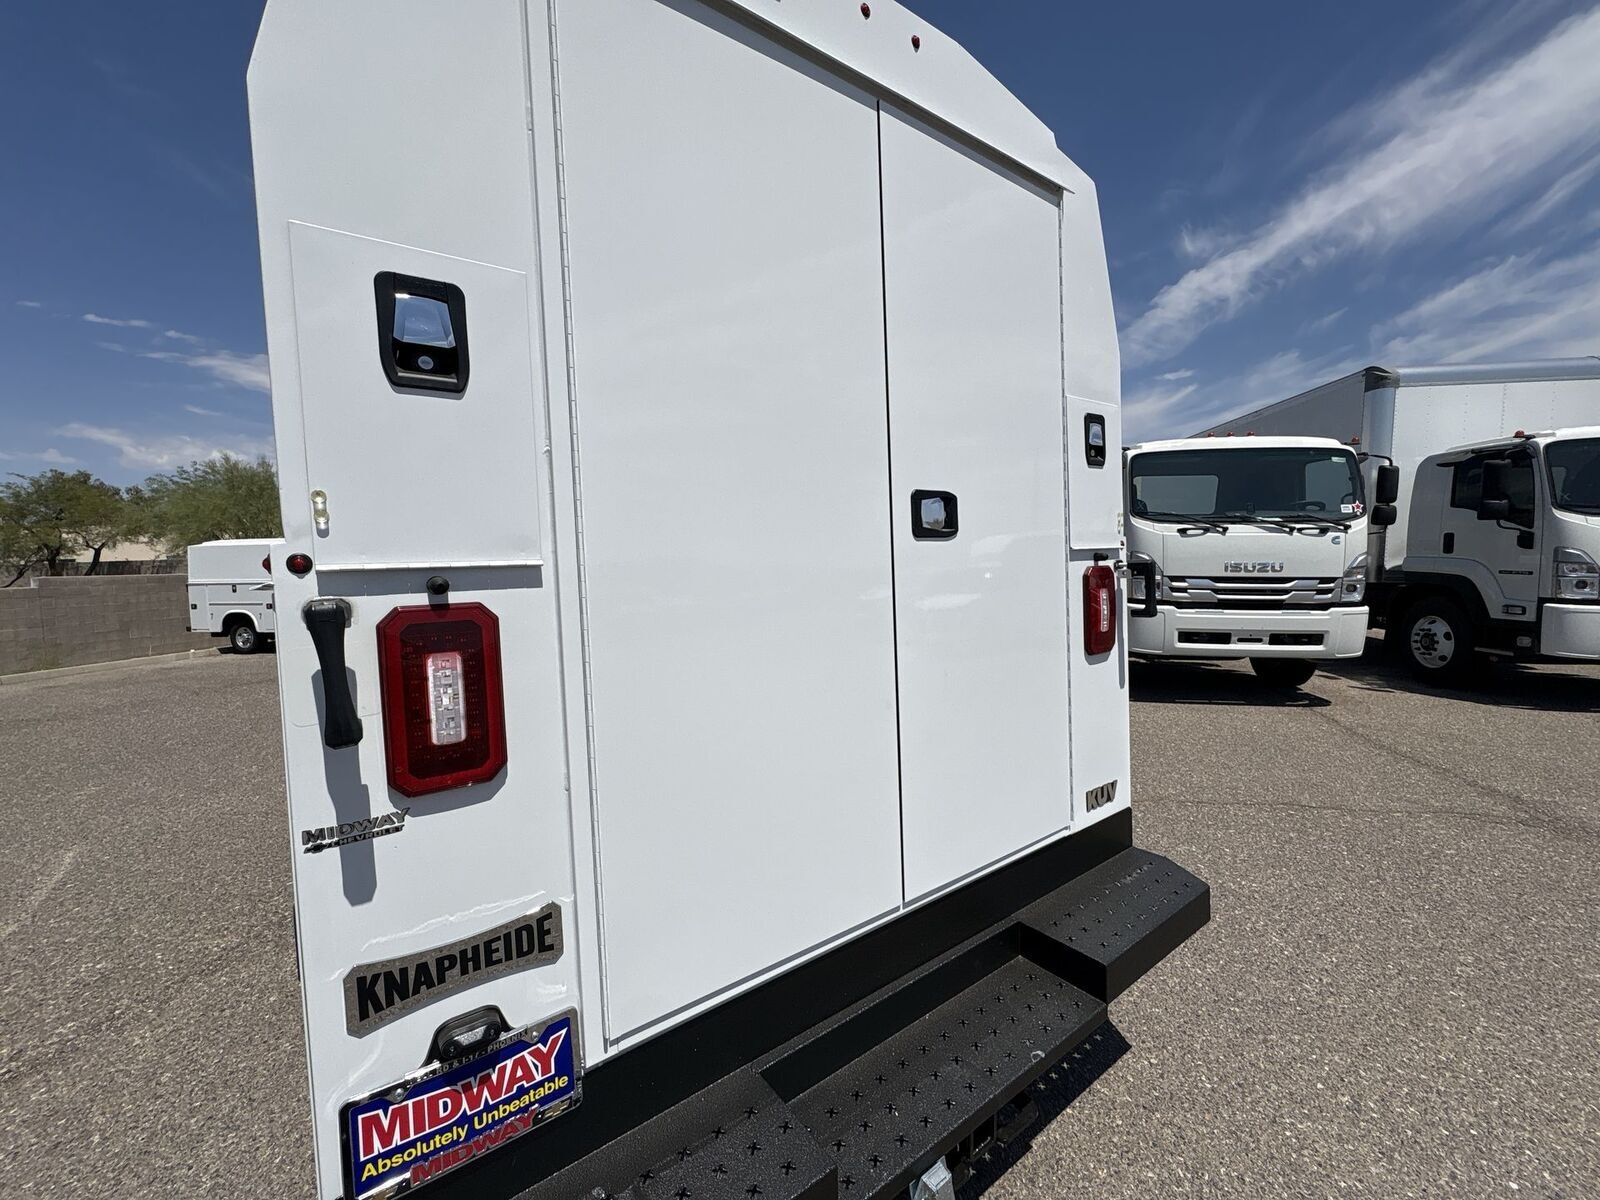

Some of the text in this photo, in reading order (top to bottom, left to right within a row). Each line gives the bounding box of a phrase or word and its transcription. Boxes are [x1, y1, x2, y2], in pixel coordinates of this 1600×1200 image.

[1223, 560, 1284, 573] ISUZU
[301, 806, 410, 846] MIDWAY
[1086, 779, 1118, 813] KUV
[332, 824, 405, 848] CHEVROLET
[356, 911, 555, 1023] KNAPHEIDE
[358, 1027, 569, 1162] MIDWAY
[361, 1123, 468, 1182] Absolutely
[473, 1075, 569, 1130] Unbeatable
[410, 1103, 540, 1188] MIDWAY
